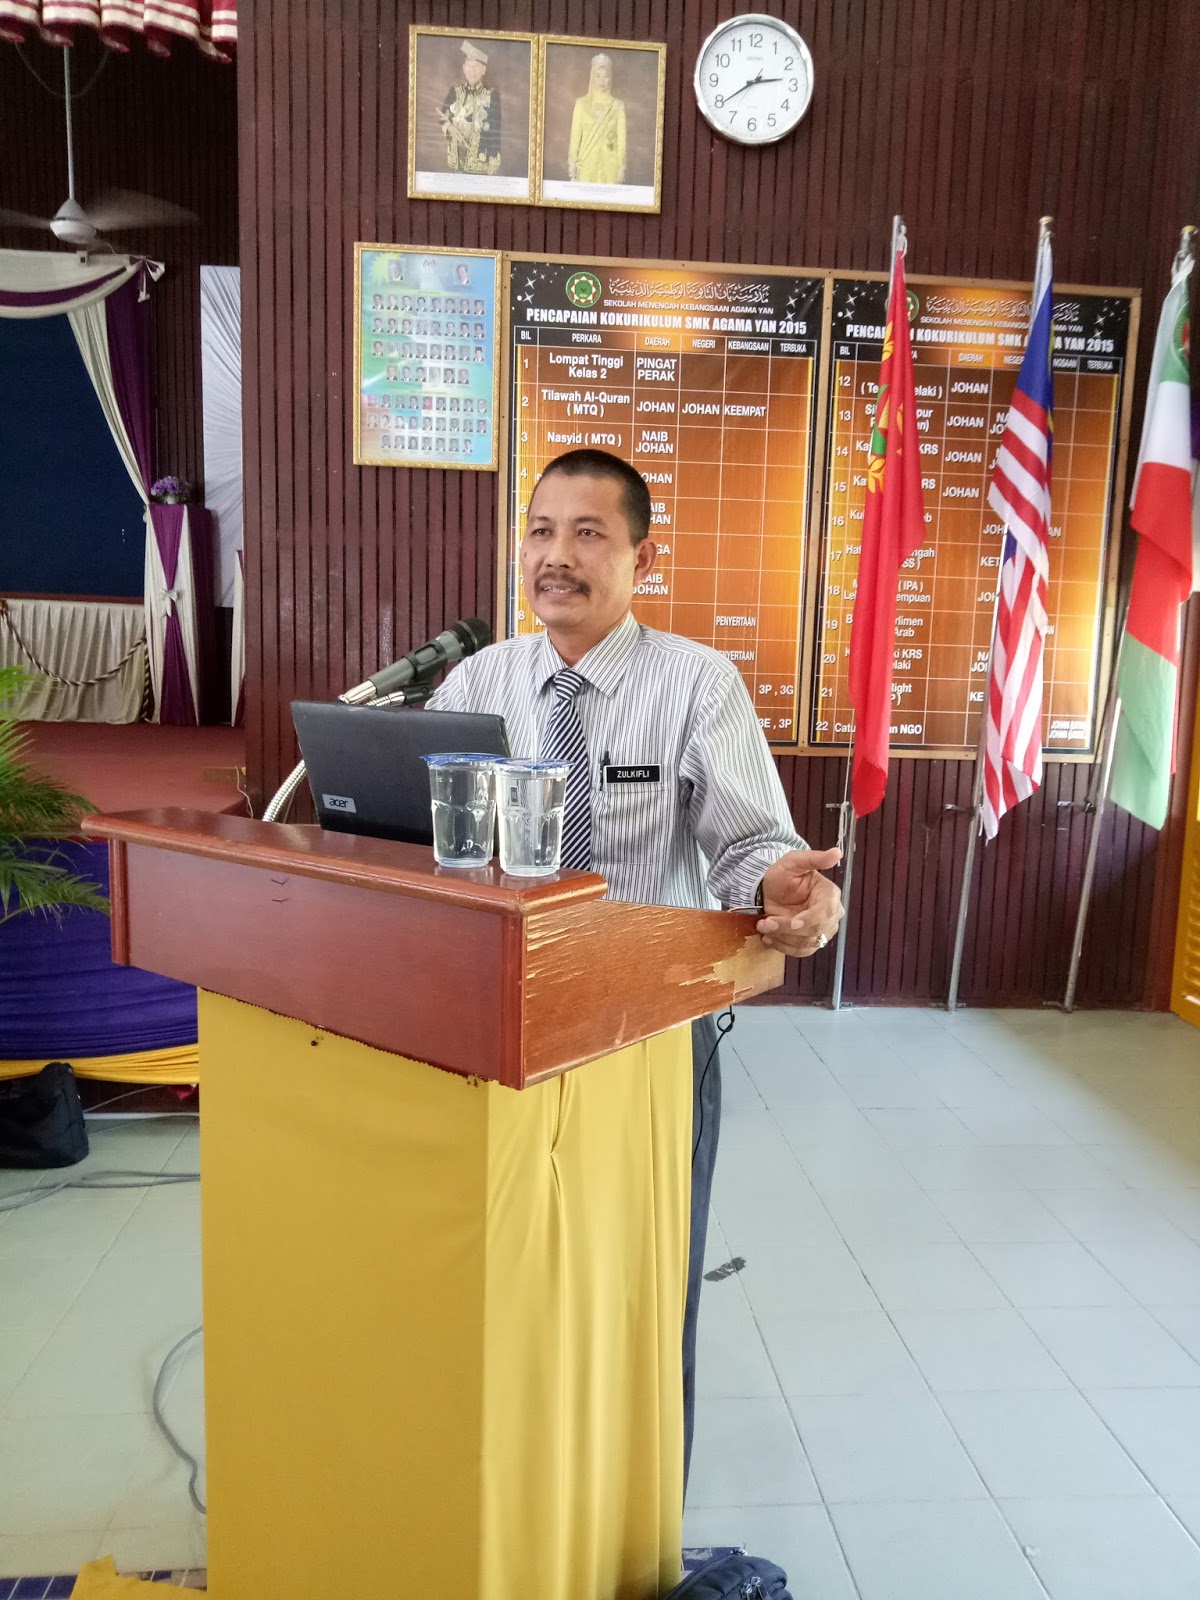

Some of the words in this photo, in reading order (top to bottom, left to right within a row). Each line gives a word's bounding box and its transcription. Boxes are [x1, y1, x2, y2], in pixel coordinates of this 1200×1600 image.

[731, 38, 742, 52] 11
[749, 33, 763, 48] 12
[773, 41, 778, 55] 1
[715, 53, 730, 68] 10
[784, 57, 794, 71] 2
[709, 73, 719, 87] 9
[789, 78, 798, 92] 3
[714, 94, 725, 109] 8
[781, 98, 790, 111] 4
[729, 110, 737, 124] 7
[767, 113, 777, 127] 5
[747, 117, 757, 131] 6
[604, 299, 637, 308] SEKOLAH
[638, 301, 680, 310] MENENGAH
[680, 303, 729, 313] KEBANGSAAN
[730, 306, 757, 314] AGAMA
[758, 307, 774, 315] YAN
[526, 307, 597, 325] PENCAPAIAN
[600, 311, 682, 329] KOKURIKULUM
[685, 316, 711, 332] SMK
[712, 318, 753, 334] AGAMA
[755, 319, 777, 333] YAN
[778, 320, 807, 335] 2015
[520, 330, 532, 341] BIL
[571, 332, 602, 344] PERKARA
[916, 328, 996, 345] KOKURIKULUM
[997, 332, 1022, 347] SMK
[645, 336, 671, 347] DAERAH
[692, 338, 716, 349] NEGERI
[728, 340, 770, 352] KEBANGSAAN
[1064, 337, 1086, 351] YAN
[1086, 338, 1114, 353] 2015
[780, 342, 807, 353] TERBUKA
[839, 346, 850, 355] BIL
[523, 358, 529, 369] 1
[549, 352, 589, 367] Lompat
[591, 354, 624, 369] Tinggi
[636, 357, 677, 370] PINGAT
[568, 366, 598, 379] Kelas
[600, 368, 608, 379] 2
[637, 369, 676, 382] PERAK
[838, 376, 851, 387] 12
[951, 382, 989, 394] JOHAN
[521, 396, 529, 407] 2
[541, 389, 582, 403] Tilawah
[583, 391, 630, 405] Al-Quran
[636, 401, 675, 413] JOHAN
[681, 402, 720, 415] JOHAN
[724, 404, 766, 417] KEEMPAT
[838, 410, 851, 421] 13
[947, 415, 985, 428] JOHAN
[520, 432, 528, 442] 3
[547, 432, 582, 445] Nasyid
[641, 430, 669, 442] NAIB
[635, 443, 674, 454] JOHAN
[836, 446, 848, 457] 14
[944, 451, 982, 463] JOHAN
[520, 468, 528, 479] 4
[639, 472, 673, 484] OHAN
[834, 482, 846, 492] 15
[942, 487, 979, 499] JOHAN
[520, 504, 527, 514] 5
[650, 502, 666, 513] AIB
[650, 514, 671, 525] HAN
[832, 516, 844, 526] 16
[830, 551, 842, 561] 17
[641, 573, 664, 584] AIB
[828, 585, 840, 595] 18
[518, 612, 525, 621] 8
[716, 616, 756, 627] PENYERTAAN
[825, 620, 838, 630] 19
[823, 653, 836, 664] 20
[902, 649, 923, 659] KRS
[759, 685, 773, 695] 3P
[780, 685, 794, 695] 3G
[821, 687, 833, 698] 21
[759, 718, 771, 728] 3E
[779, 719, 792, 729] 3P
[815, 721, 829, 731] 22
[900, 724, 923, 735] NGO
[616, 769, 650, 779] ZULKIFLI
[329, 797, 349, 808] acer
